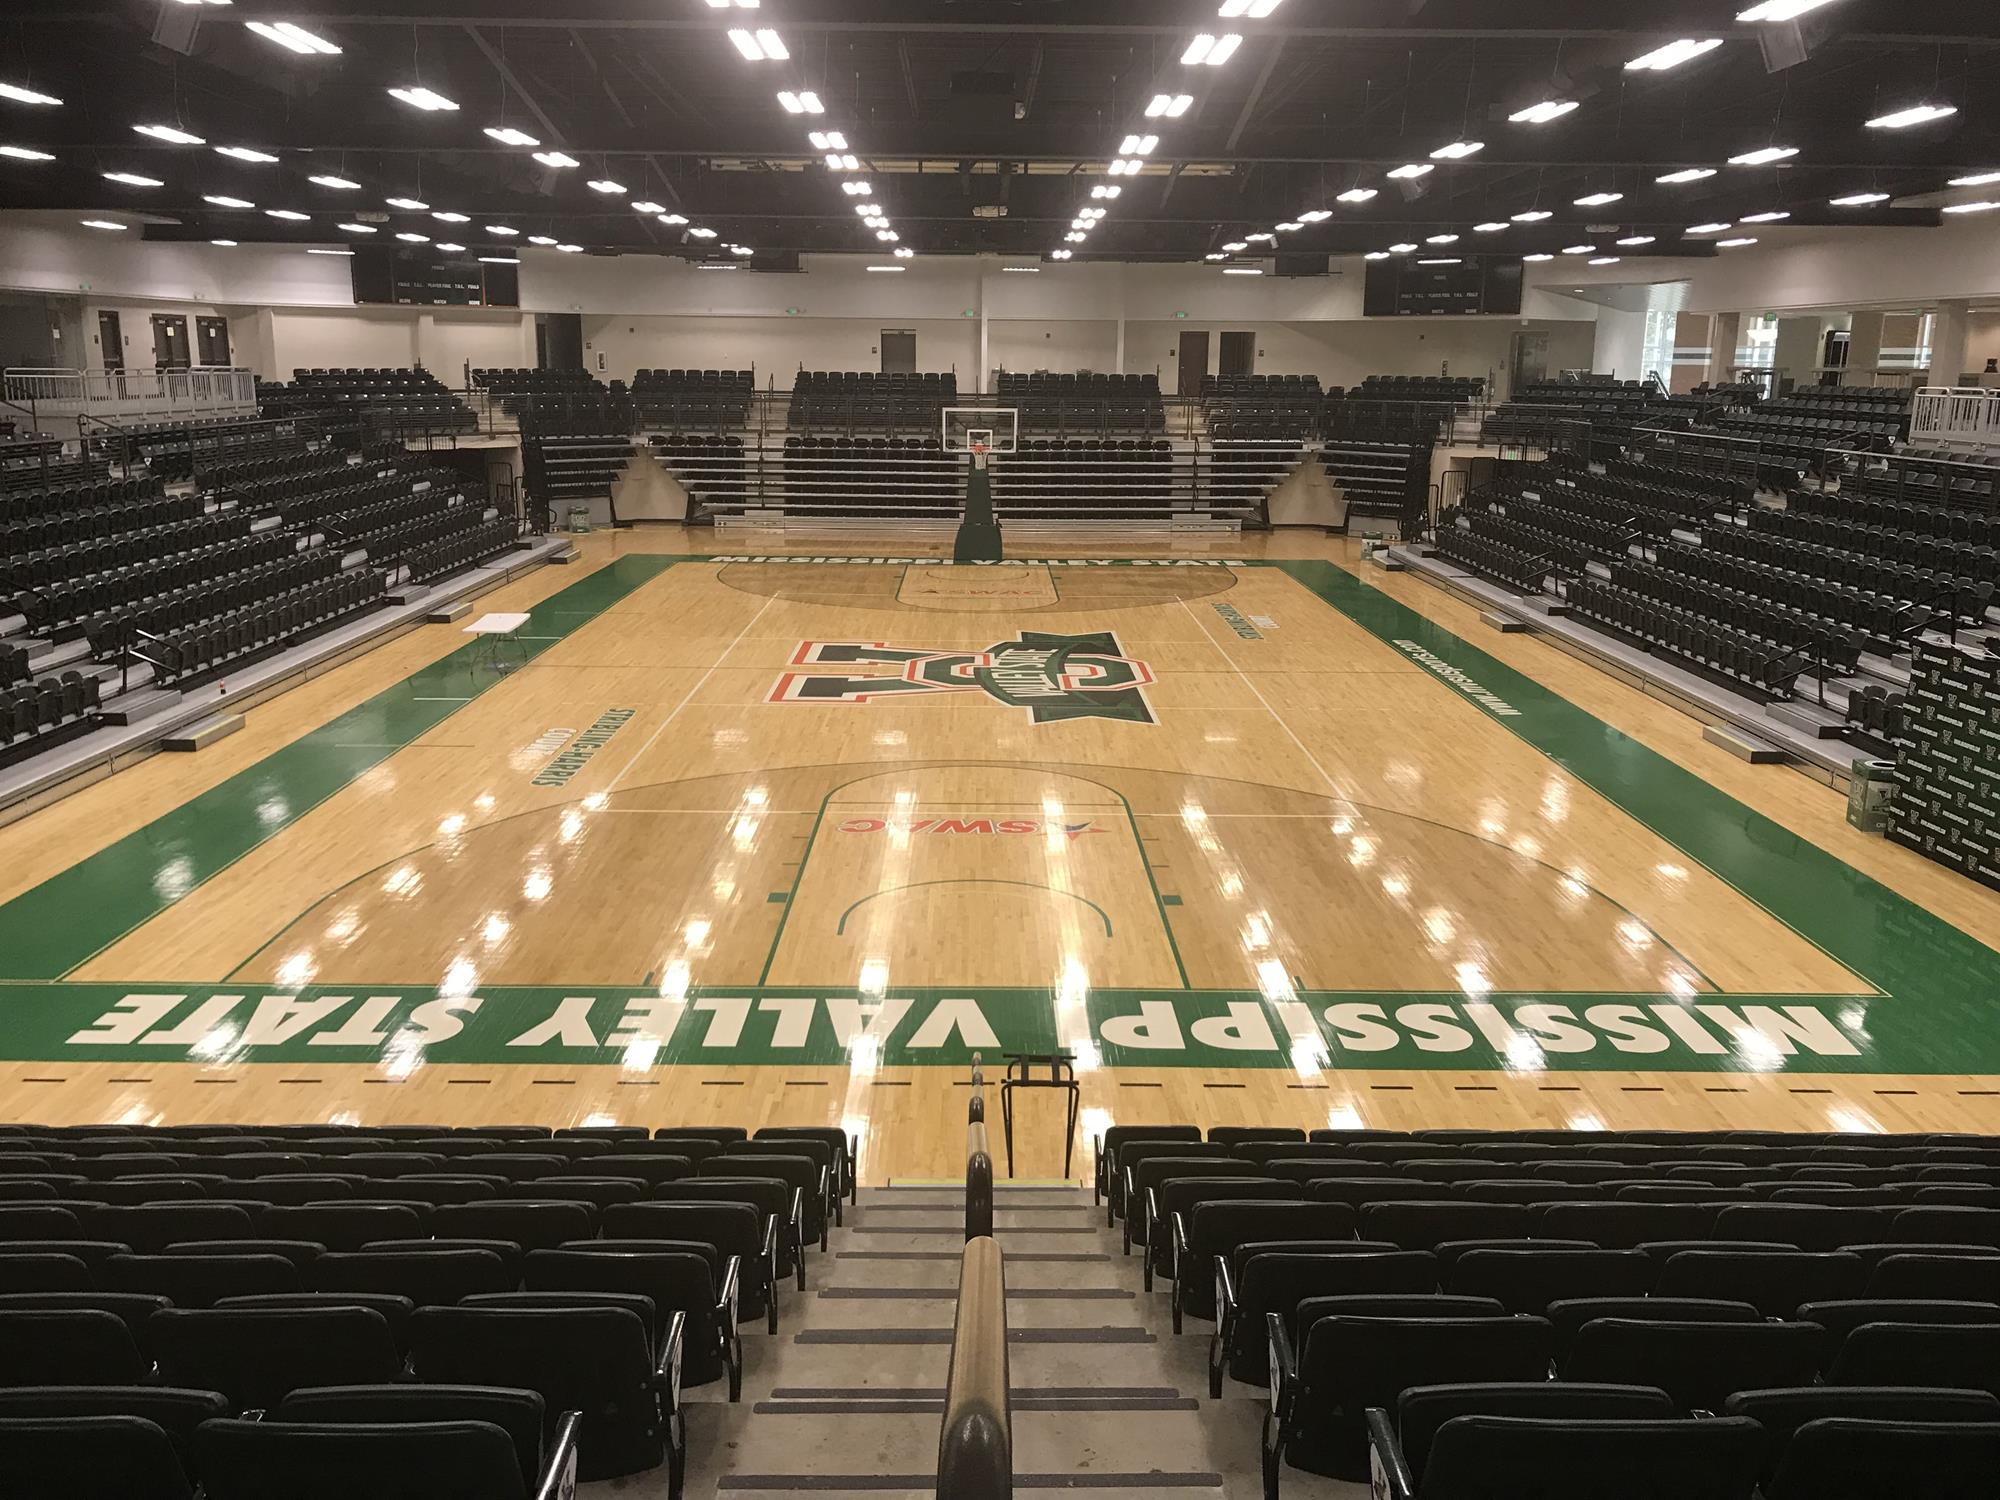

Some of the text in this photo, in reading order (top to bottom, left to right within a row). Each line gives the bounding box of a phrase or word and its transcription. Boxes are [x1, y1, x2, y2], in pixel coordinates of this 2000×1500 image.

[709, 556, 954, 565] MISSISSIPPI
[990, 649, 1069, 698] VALLEY STATE
[530, 707, 636, 787] STRIBLING-HARRIS
[838, 819, 1038, 834] SWAC
[65, 994, 1862, 1056] MISSISSIPPI VALLEY STATE
